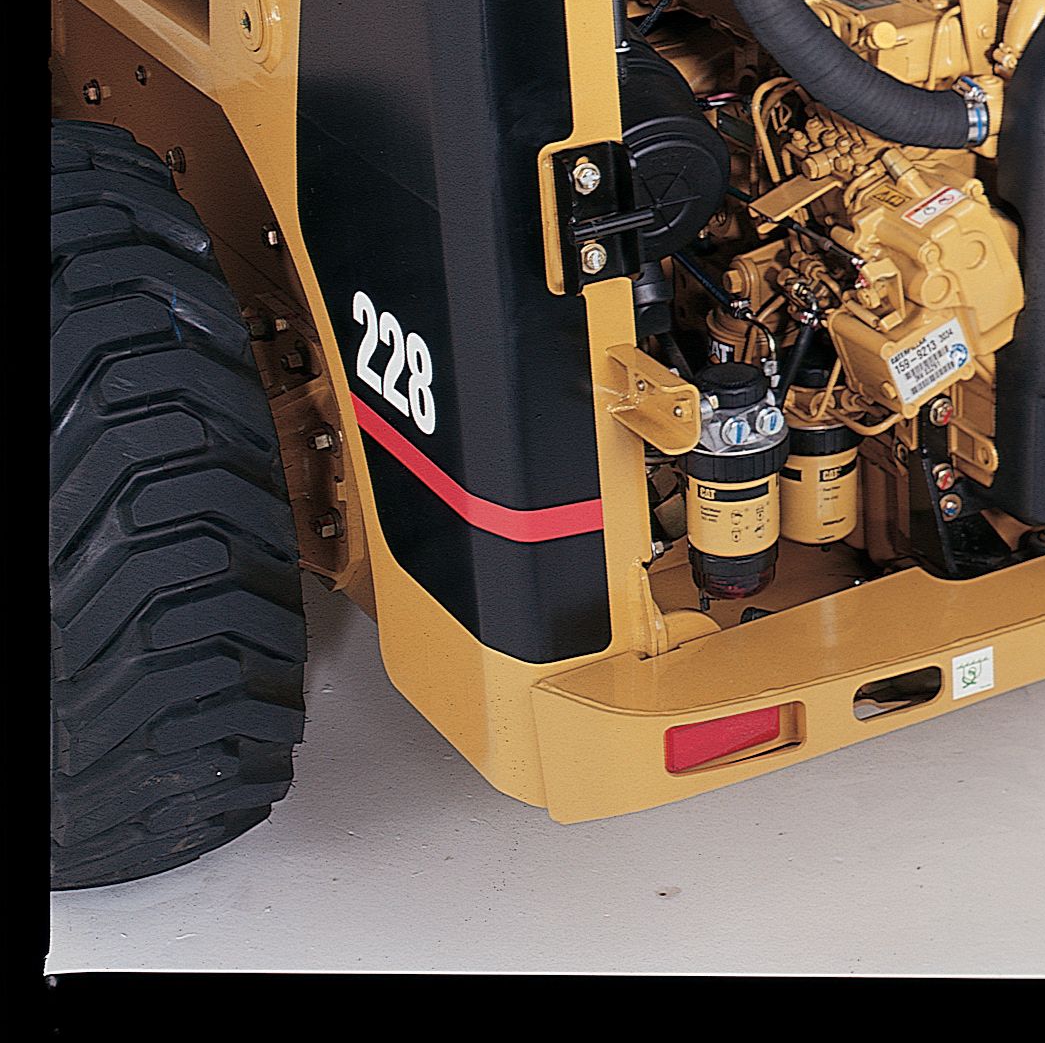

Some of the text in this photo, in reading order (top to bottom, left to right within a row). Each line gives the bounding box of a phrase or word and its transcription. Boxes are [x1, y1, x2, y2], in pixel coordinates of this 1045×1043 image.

[352, 290, 436, 435] 228
[711, 340, 734, 364] AT
[699, 486, 716, 500] CAT
